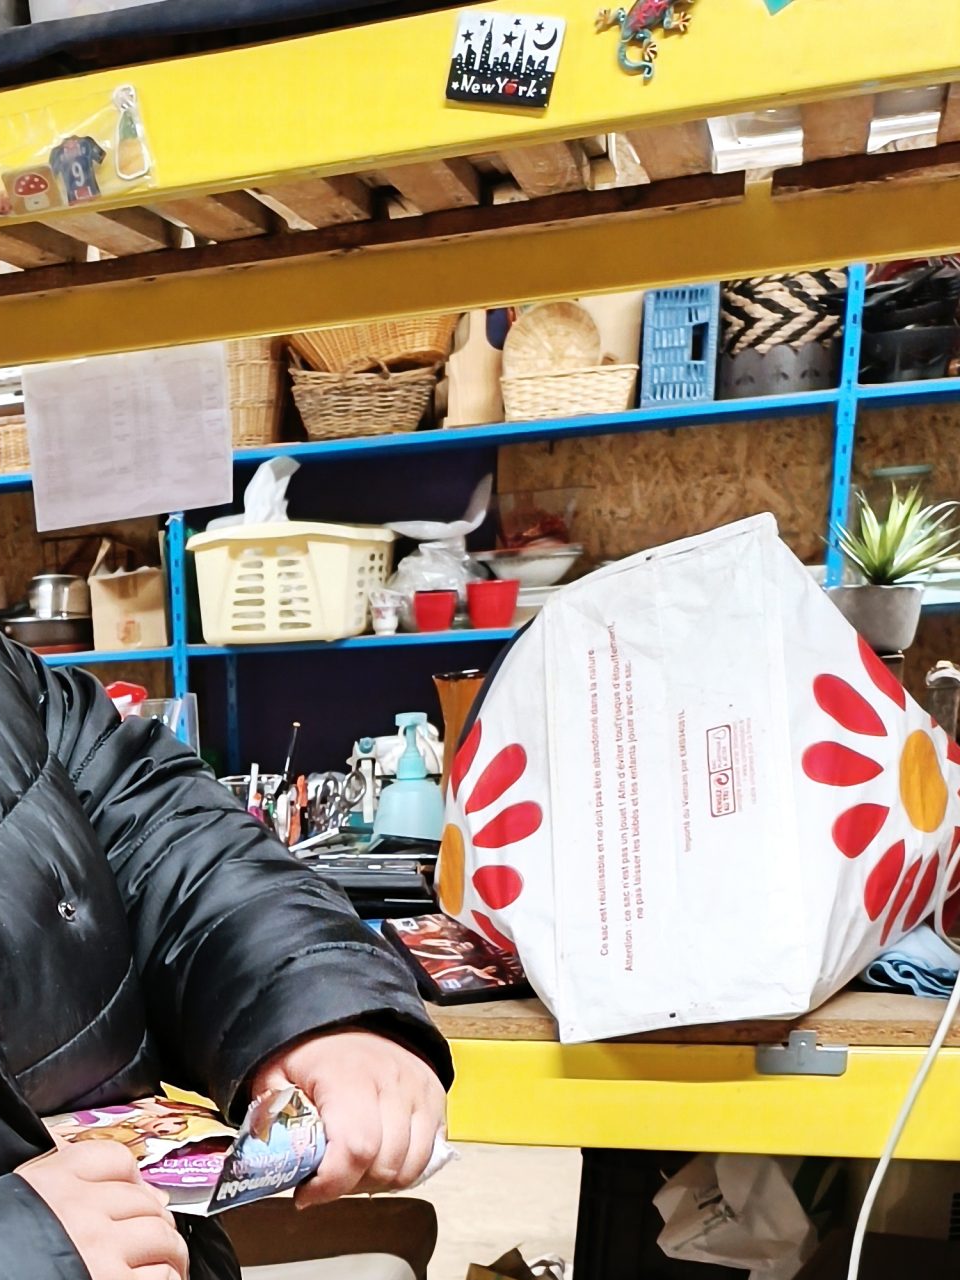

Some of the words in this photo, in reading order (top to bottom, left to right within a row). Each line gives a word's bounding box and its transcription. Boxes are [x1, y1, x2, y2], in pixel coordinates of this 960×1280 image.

[71, 161, 85, 187] 9
[589, 682, 597, 691] la
[625, 681, 632, 691] ce
[589, 693, 598, 714] dans
[615, 723, 623, 741] tout
[627, 719, 638, 742] jouer
[590, 718, 600, 768] abandonné
[628, 745, 637, 779] enfants
[593, 771, 601, 788] être
[618, 781, 626, 799] Afin
[630, 782, 638, 795] les
[595, 791, 604, 807] pas
[630, 798, 638, 806] et
[595, 810, 603, 827] doit
[619, 808, 629, 830] jouet
[631, 809, 640, 835] bébés
[596, 830, 604, 841] ne
[620, 833, 628, 844] un
[597, 844, 604, 852] et
[632, 839, 640, 852] les
[621, 848, 630, 863] pas
[633, 855, 642, 885] laisser
[635, 888, 645, 904] pas
[599, 908, 607, 922] est
[625, 910, 632, 921] ce
[636, 908, 644, 918] ne
[600, 925, 608, 940] sac
[600, 943, 609, 956] Ce
[625, 930, 633, 971] Attention
[216, 1165, 299, 1200] playmobil
